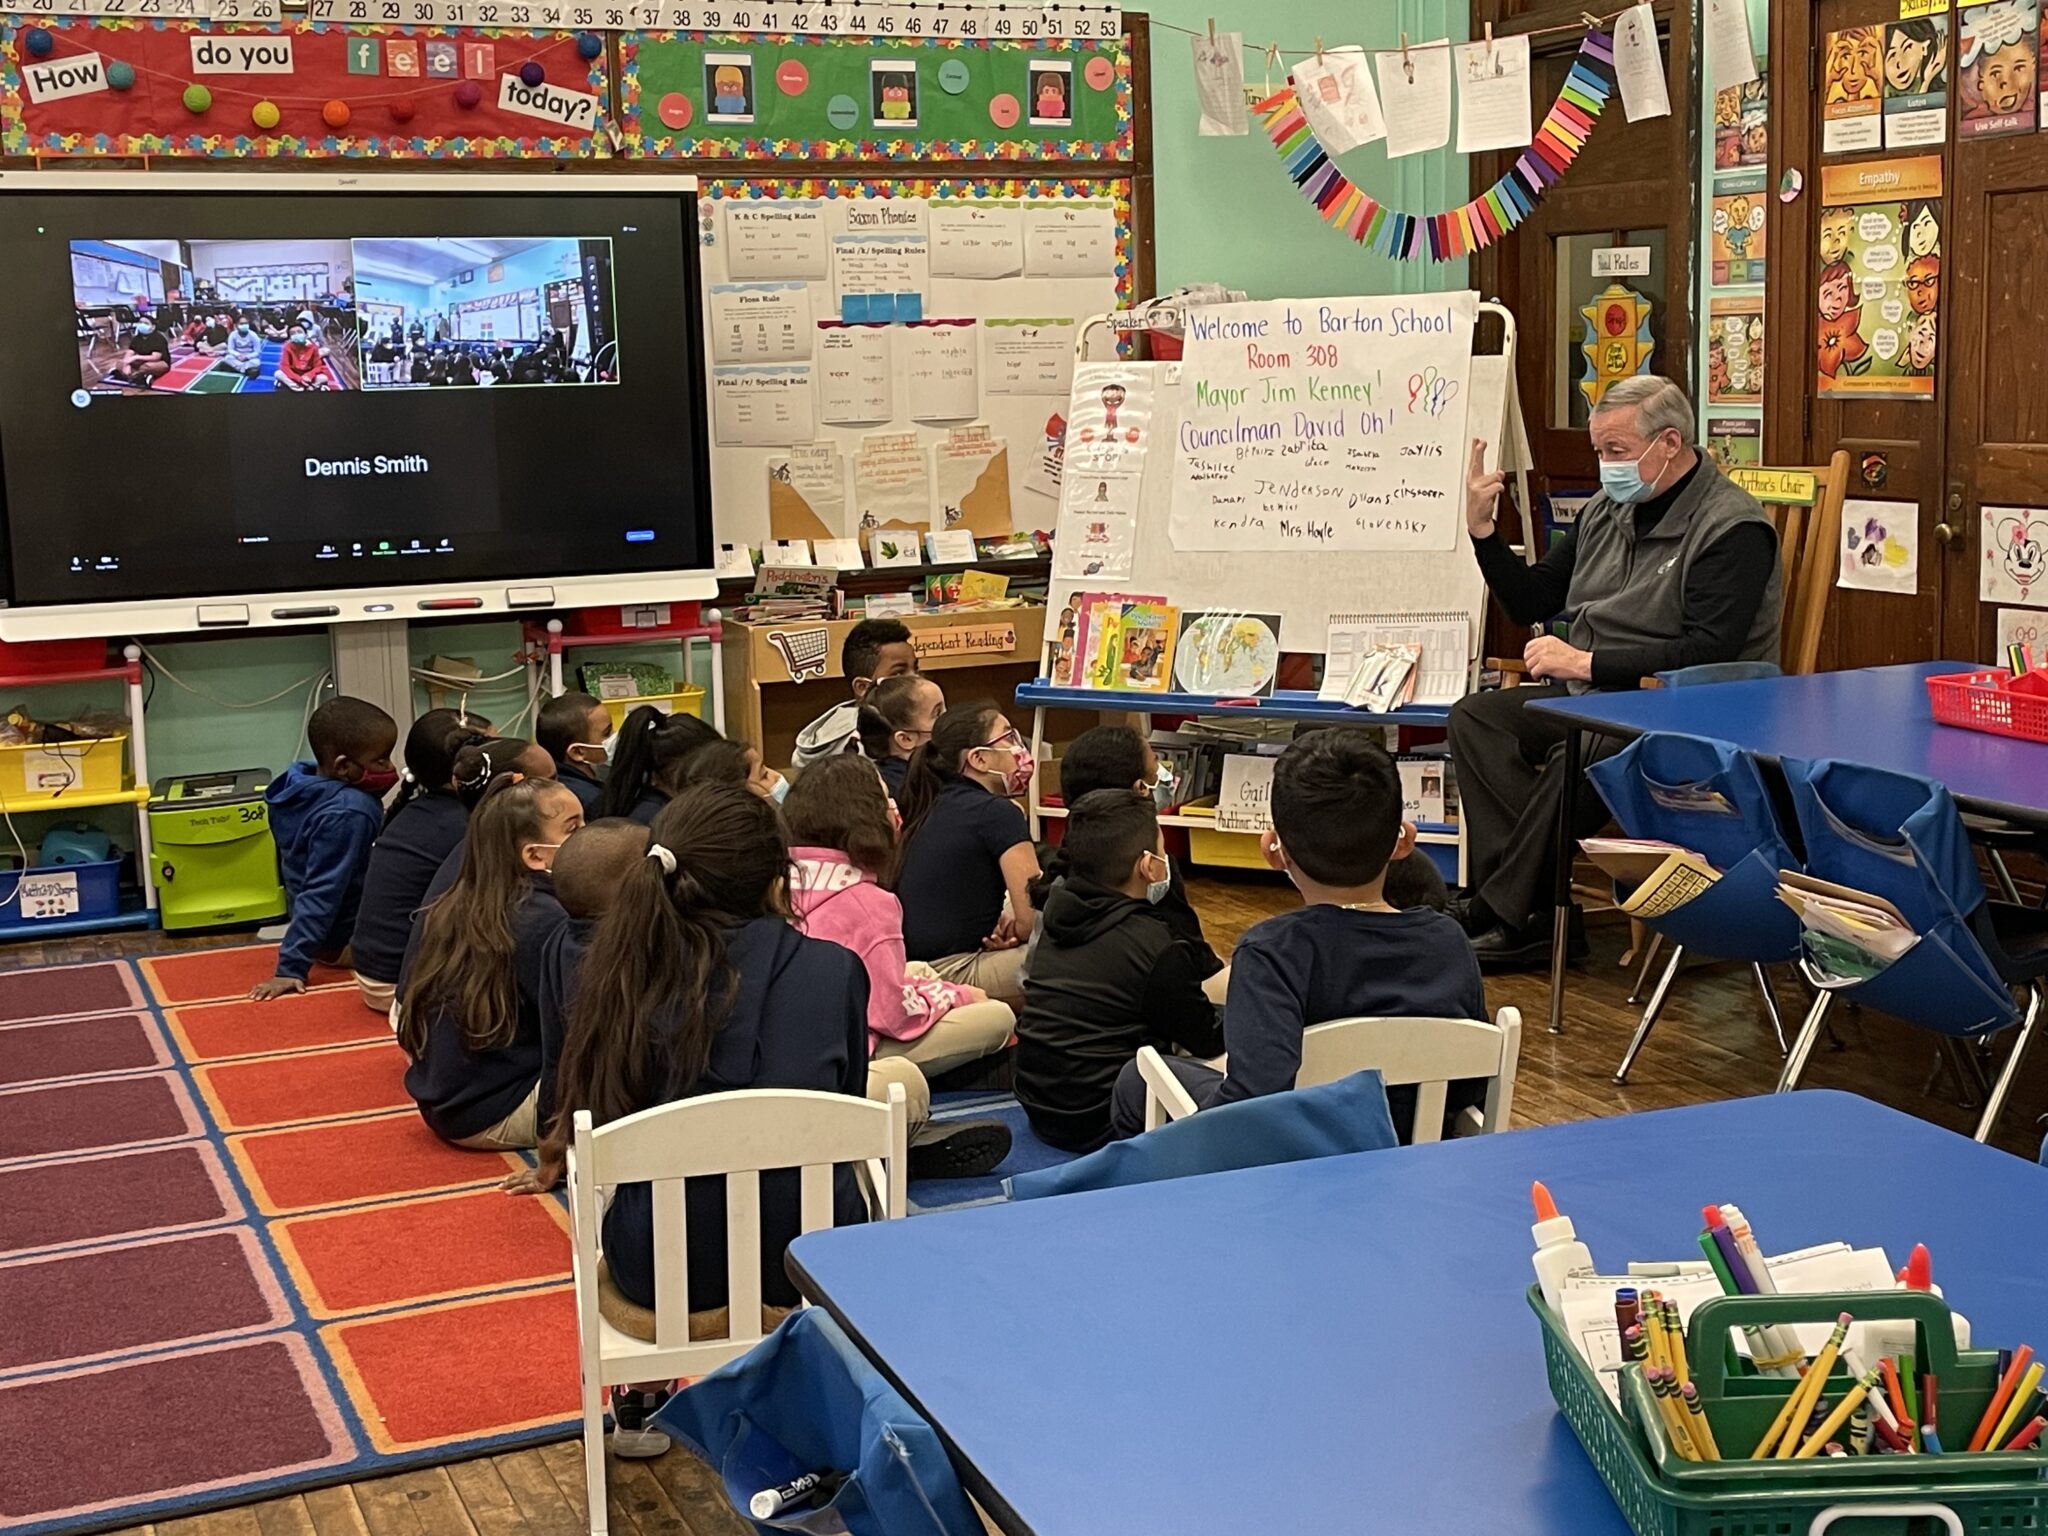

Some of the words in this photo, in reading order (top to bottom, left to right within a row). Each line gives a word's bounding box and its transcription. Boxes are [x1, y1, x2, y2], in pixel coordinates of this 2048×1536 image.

[105, 0, 125, 12] 22
[140, 0, 160, 12] 23
[175, 0, 195, 14] 24
[218, 0, 239, 16] 25
[252, 1, 272, 17] 26
[315, 1, 334, 17] 27
[350, 1, 367, 18] 28
[382, 2, 400, 19] 29
[414, 3, 434, 20] 30
[447, 4, 464, 21] 31
[479, 5, 498, 22] 32
[511, 6, 530, 23] 33
[542, 7, 560, 24] 34
[574, 8, 593, 25] 35
[605, 9, 623, 25] 36
[643, 10, 660, 25] 37
[673, 11, 691, 26] 38
[703, 11, 721, 27] 39
[733, 12, 751, 28] 40
[762, 13, 778, 29] 41
[792, 14, 808, 30] 42
[820, 15, 838, 31] 43
[850, 16, 866, 31] 44
[877, 17, 894, 33] 45
[905, 17, 922, 34] 46
[932, 18, 949, 34] 47
[960, 19, 977, 35] 48
[995, 19, 1012, 35] 49
[1022, 19, 1038, 35] 50
[1048, 19, 1063, 34] 51
[1074, 20, 1091, 36] 52
[1100, 20, 1116, 37] 53
[33, 64, 98, 93] How
[197, 40, 231, 65] do
[239, 44, 289, 71] you
[358, 43, 484, 75] feel
[507, 82, 592, 122] today?
[1859, 171, 1900, 186] Empathy
[849, 208, 879, 225] Saxon
[881, 207, 917, 225] Phonics
[871, 247, 902, 255] Spelling
[1105, 313, 1145, 334] Speaker
[1190, 313, 1269, 341] Welcome
[1283, 307, 1302, 336] to
[1320, 306, 1383, 333] Barton
[1389, 306, 1452, 337] School
[1247, 343, 1291, 369] Room
[1306, 344, 1338, 368] 308
[1197, 380, 1250, 412] Mayor
[1259, 376, 1296, 404] Jim
[1181, 415, 1281, 452] Councilman
[1294, 408, 1345, 439] David
[305, 457, 371, 477] Dennis
[374, 455, 429, 474] Smith
[1738, 471, 1777, 492] Author's
[1781, 473, 1805, 494] Chair
[913, 633, 961, 656] dependent
[965, 631, 1004, 649] Reading
[1240, 781, 1270, 802] Gail
[1254, 812, 1274, 832] Stu
